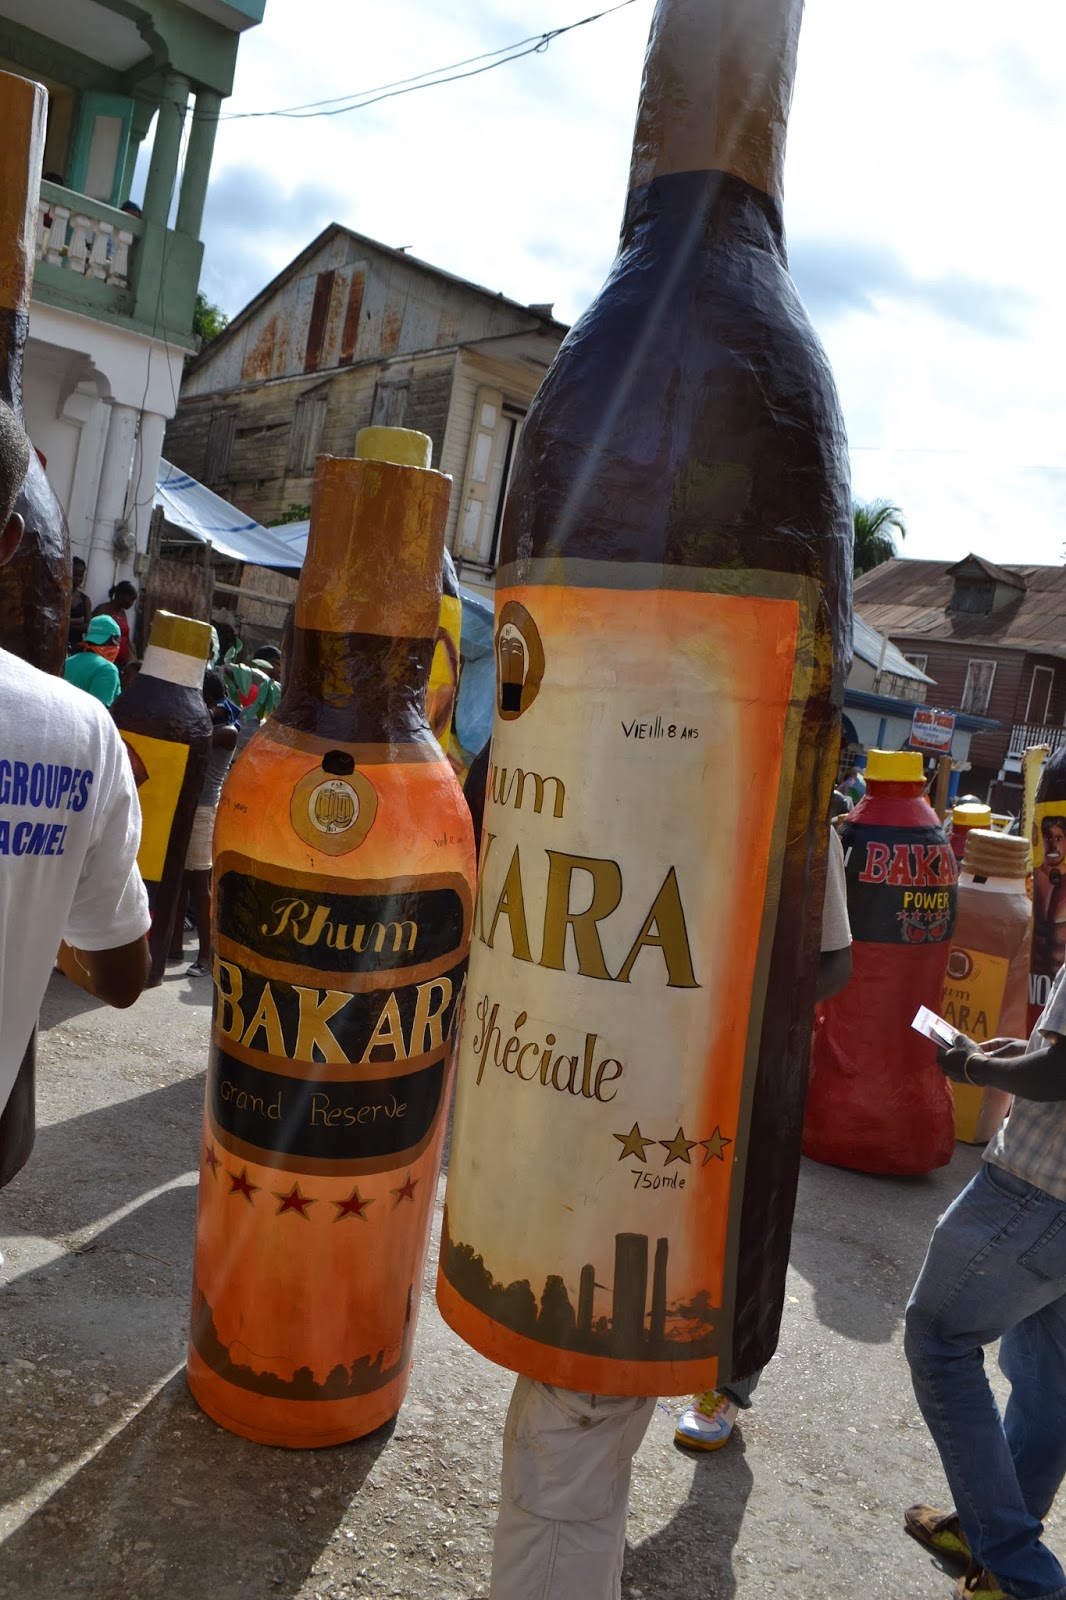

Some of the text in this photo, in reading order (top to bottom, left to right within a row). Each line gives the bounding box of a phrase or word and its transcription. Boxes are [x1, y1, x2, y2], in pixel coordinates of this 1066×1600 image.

[667, 724, 677, 738] 8
[680, 726, 699, 739] ANS
[0, 820, 68, 856] ACMEL
[903, 891, 949, 909] POWER
[261, 898, 418, 953] Rhum
[220, 1080, 407, 1126] Grand Reserve
